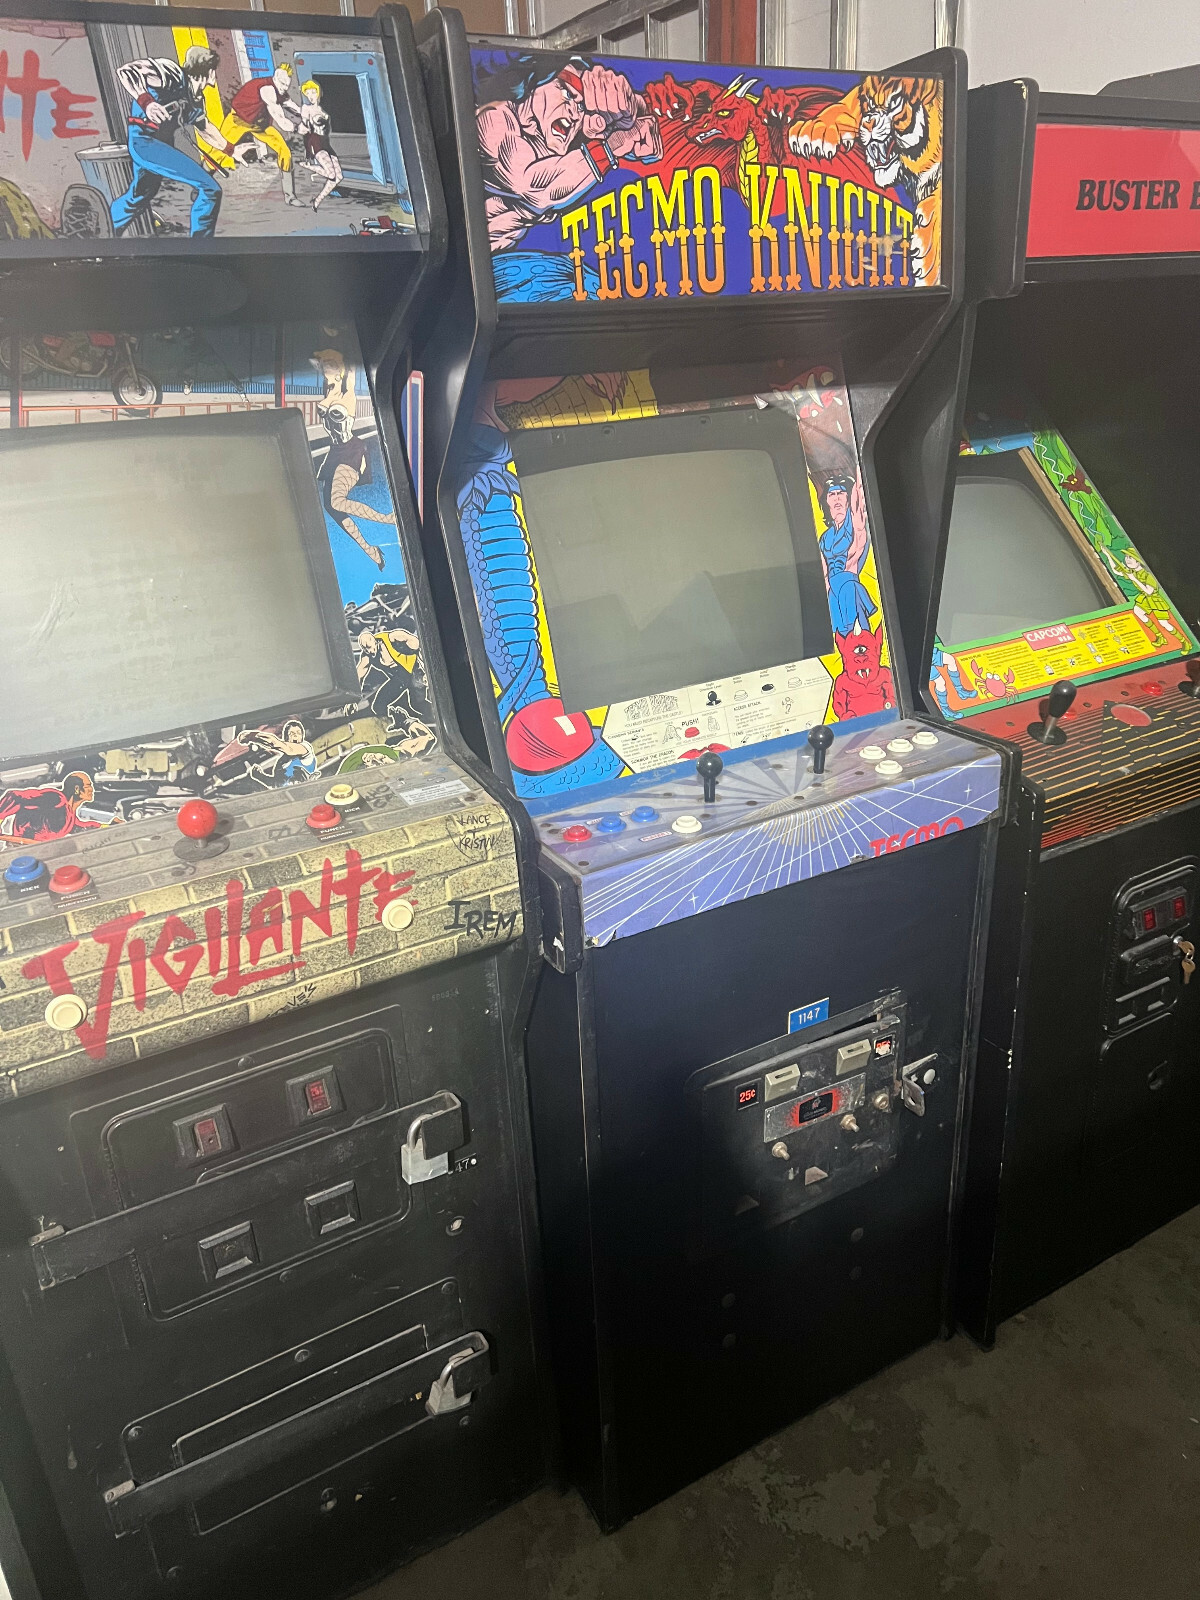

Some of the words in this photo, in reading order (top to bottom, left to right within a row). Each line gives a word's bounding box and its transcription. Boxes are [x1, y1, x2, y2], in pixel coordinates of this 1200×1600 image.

[1076, 179, 1180, 211] BUSTER
[562, 166, 727, 301] TECMO
[745, 163, 914, 292] KNIGHT
[1026, 626, 1067, 642] CAPCOM
[444, 900, 518, 941] IREM
[798, 1007, 821, 1025] 1147
[739, 1089, 756, 1103] 25¢
